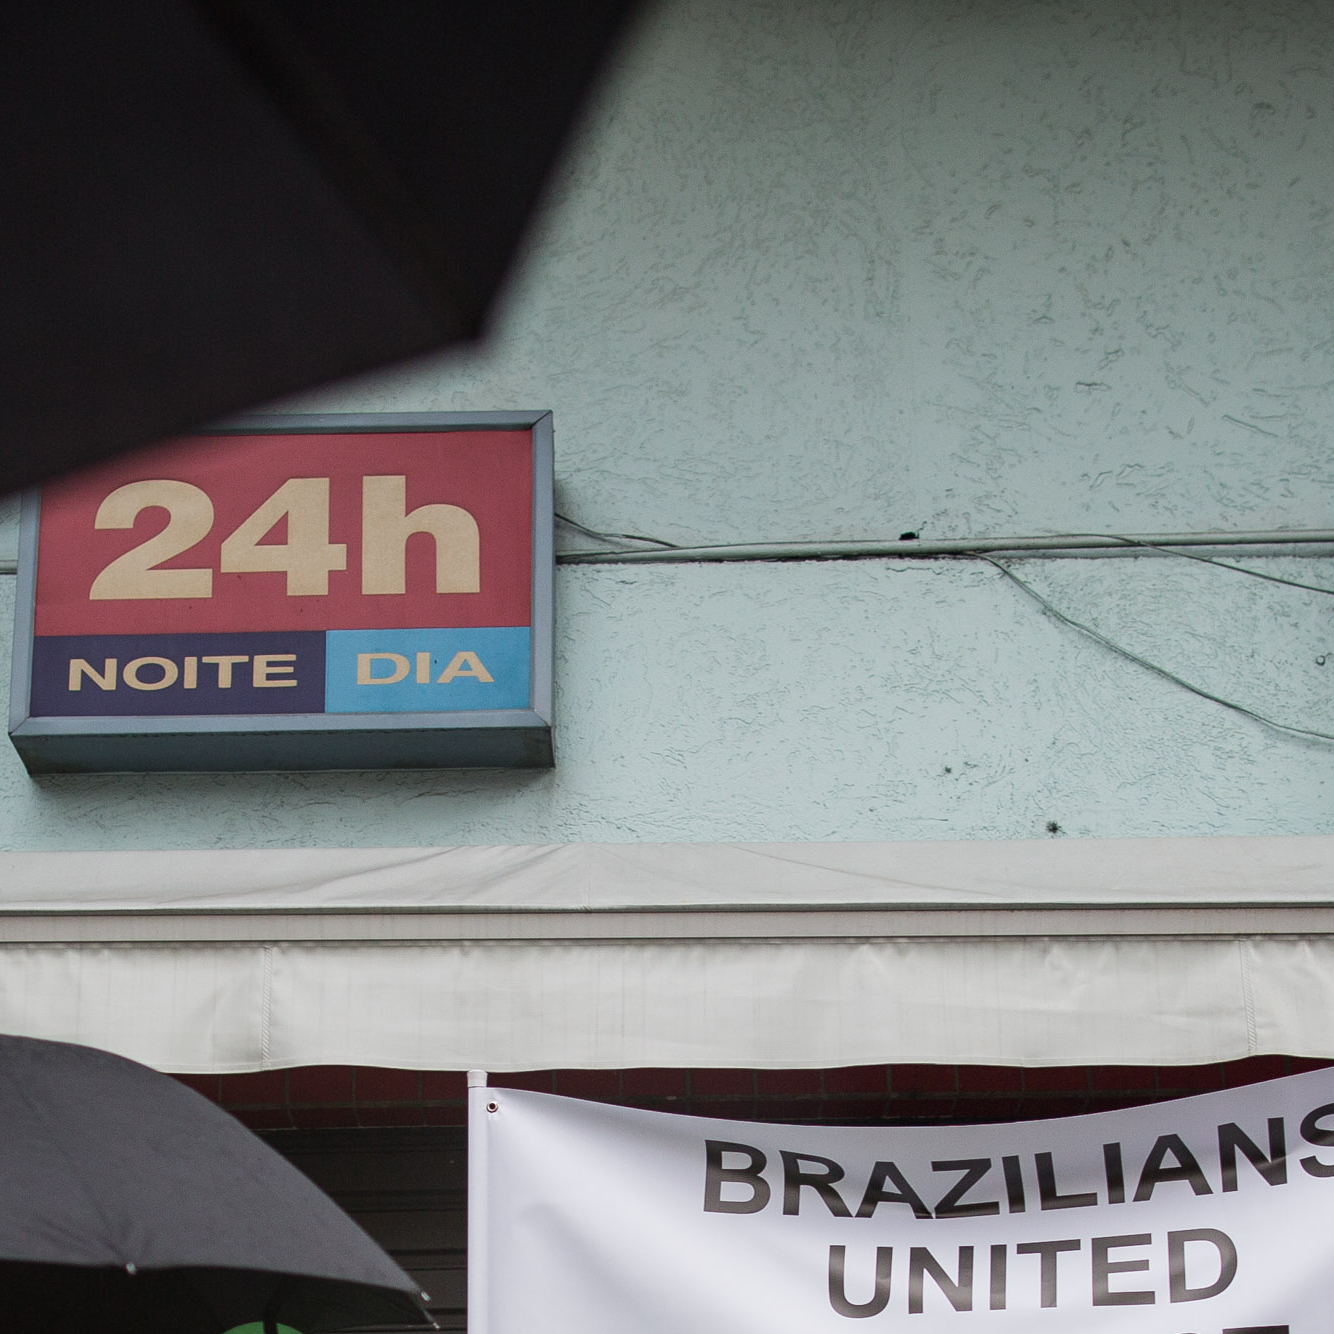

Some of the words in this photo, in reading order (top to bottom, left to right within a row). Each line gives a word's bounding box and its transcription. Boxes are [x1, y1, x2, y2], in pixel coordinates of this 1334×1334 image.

[89, 474, 481, 601] 24h
[68, 653, 298, 691] NOITE
[357, 650, 495, 685] DIA
[827, 1227, 1239, 1319] UNITED
